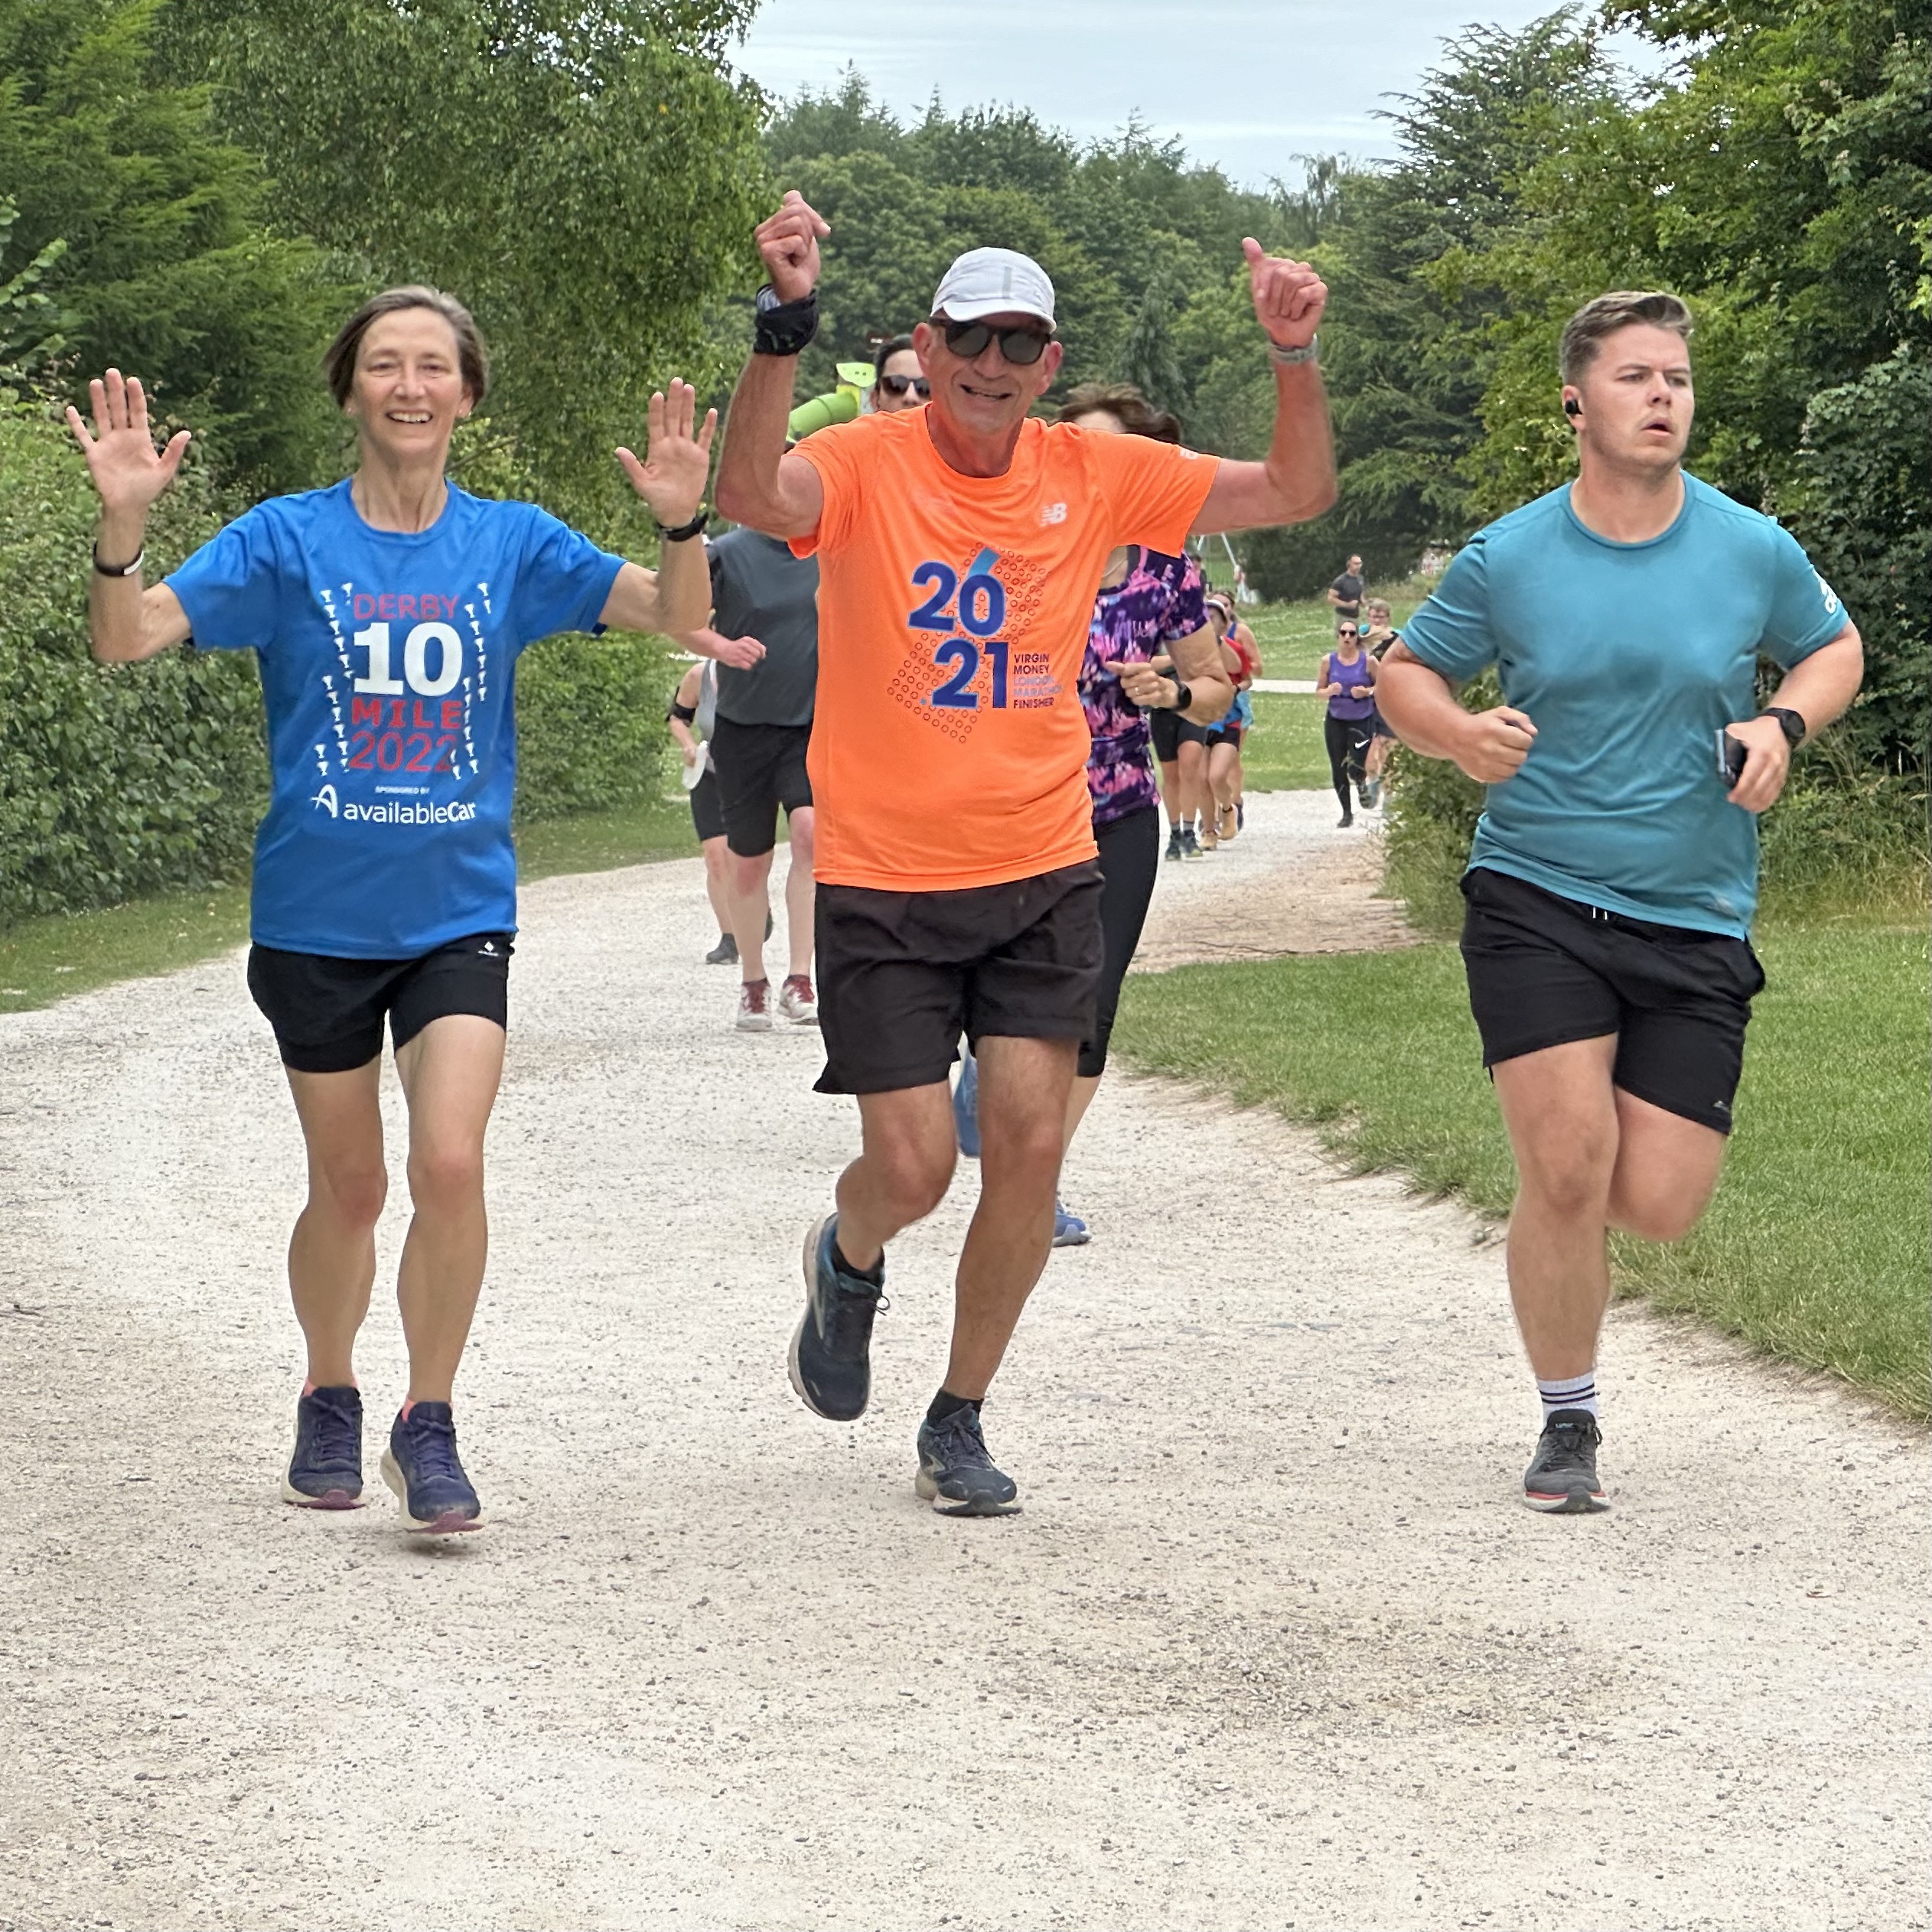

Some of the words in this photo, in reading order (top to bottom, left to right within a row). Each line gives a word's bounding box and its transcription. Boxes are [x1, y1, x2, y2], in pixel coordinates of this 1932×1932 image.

[353, 594, 459, 619] DERBY
[353, 621, 463, 696] 10
[1014, 653, 1049, 663] VIRGIN
[1014, 664, 1049, 674] MONEY
[931, 637, 1008, 708] 21
[1014, 684, 1062, 697] MARAT
[351, 698, 463, 729] MILE
[348, 731, 458, 772] 2022
[344, 801, 477, 824] availableCar
